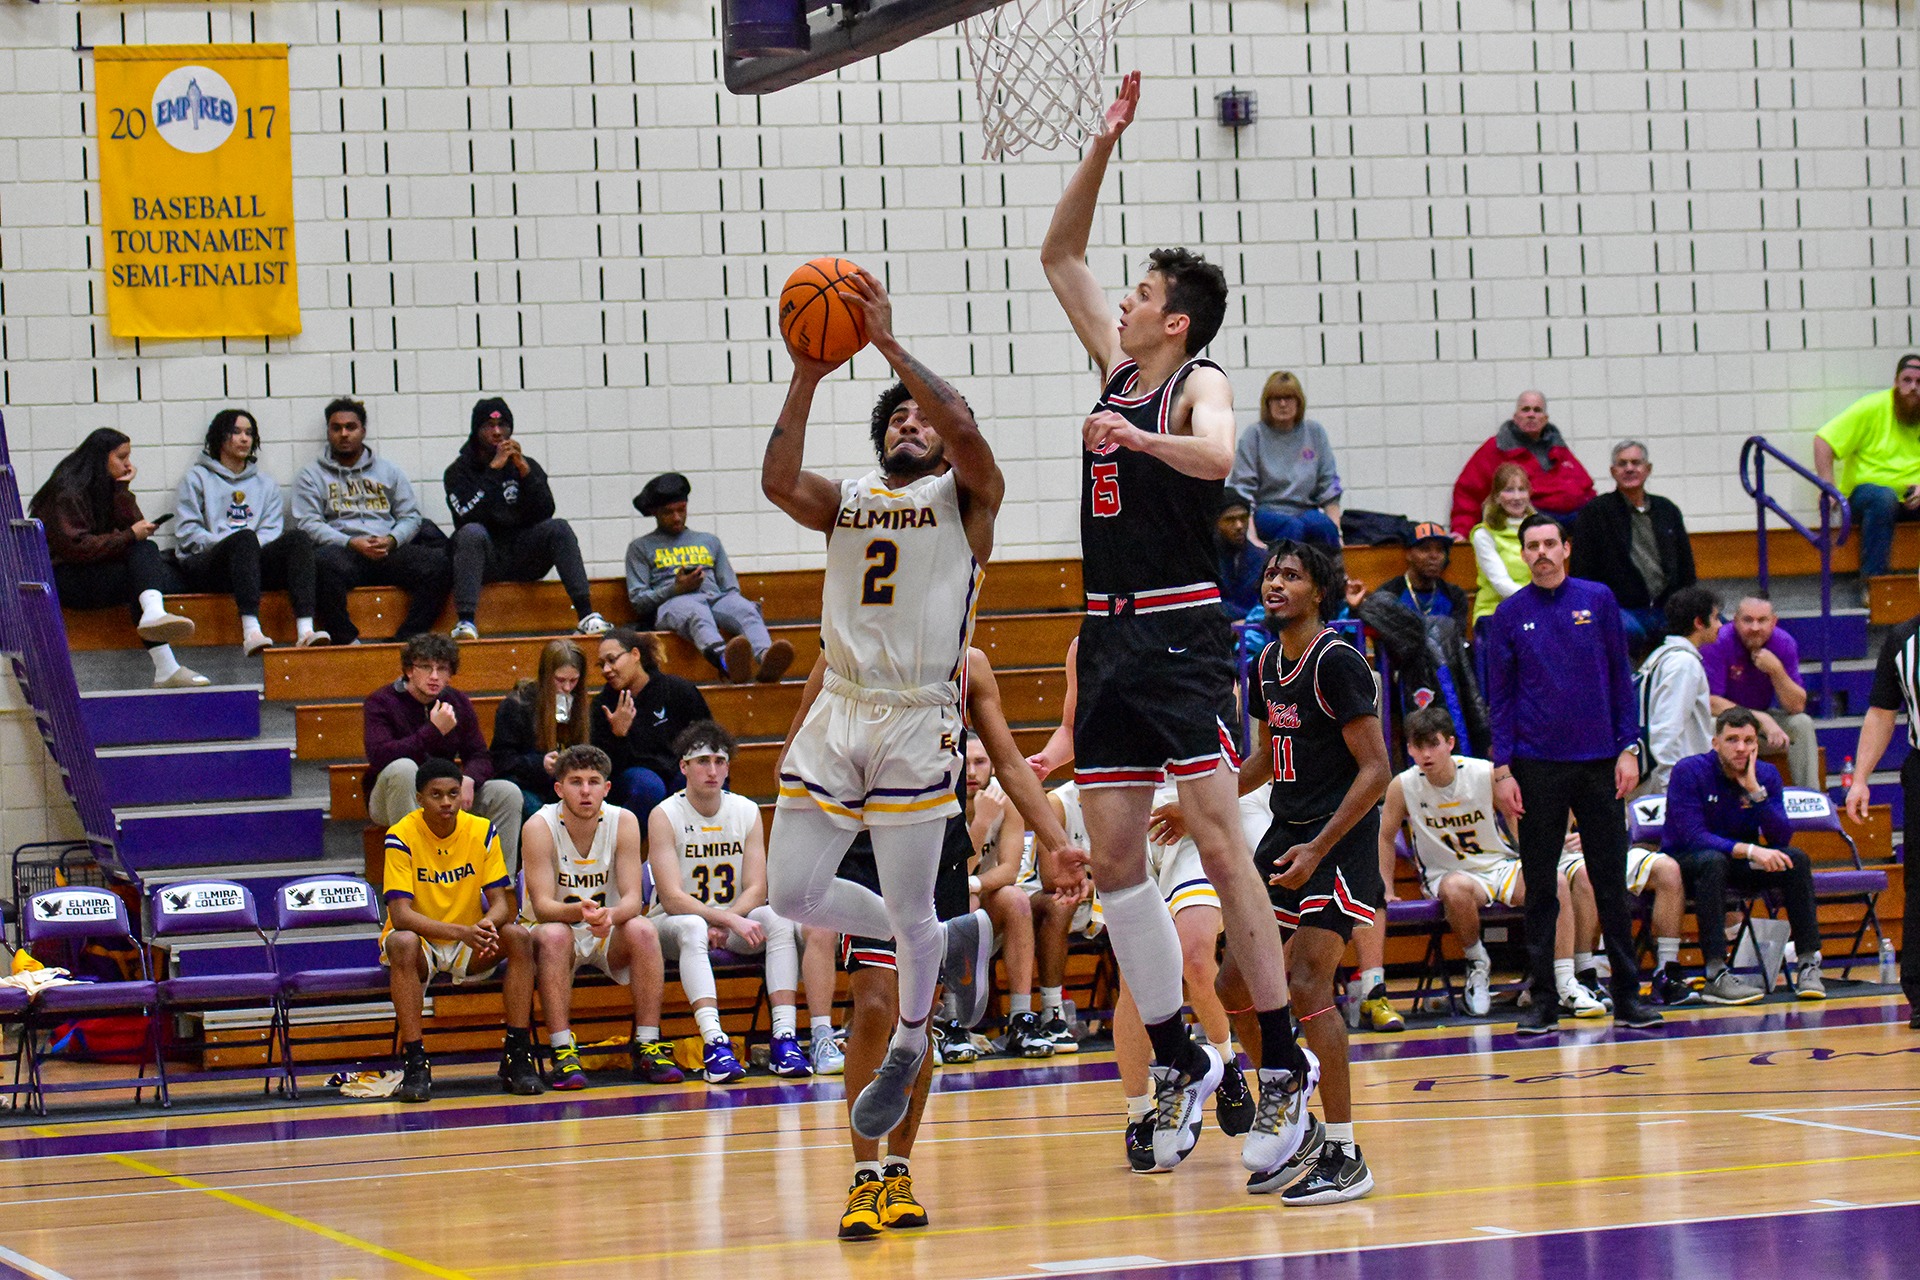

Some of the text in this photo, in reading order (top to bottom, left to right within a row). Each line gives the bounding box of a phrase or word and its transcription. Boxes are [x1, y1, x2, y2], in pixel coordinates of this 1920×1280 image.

[109, 107, 146, 140] 20
[244, 105, 276, 140] 17
[132, 195, 266, 221] BASEBALL
[110, 227, 288, 254] TOURNAMENT
[112, 261, 289, 288] SEMI-FINALIST
[1091, 461, 1123, 518] 5
[836, 506, 938, 531] ELMIRA
[655, 545, 710, 559] ELMIRA
[861, 537, 900, 607] 2
[1114, 597, 1128, 615] W
[1272, 735, 1297, 782] 11
[1788, 797, 1823, 806] ELMIRA
[1426, 809, 1486, 829] ELMIRA
[685, 841, 744, 858] ELMIRA
[1441, 830, 1484, 861] 15
[416, 862, 476, 884] ELMIRA
[690, 862, 737, 906] 33
[69, 898, 110, 908] ELMIRA
[197, 889, 238, 900] ELMIRA
[320, 886, 362, 897] ELMIRA
[1364, 1062, 1656, 1092] Pat
